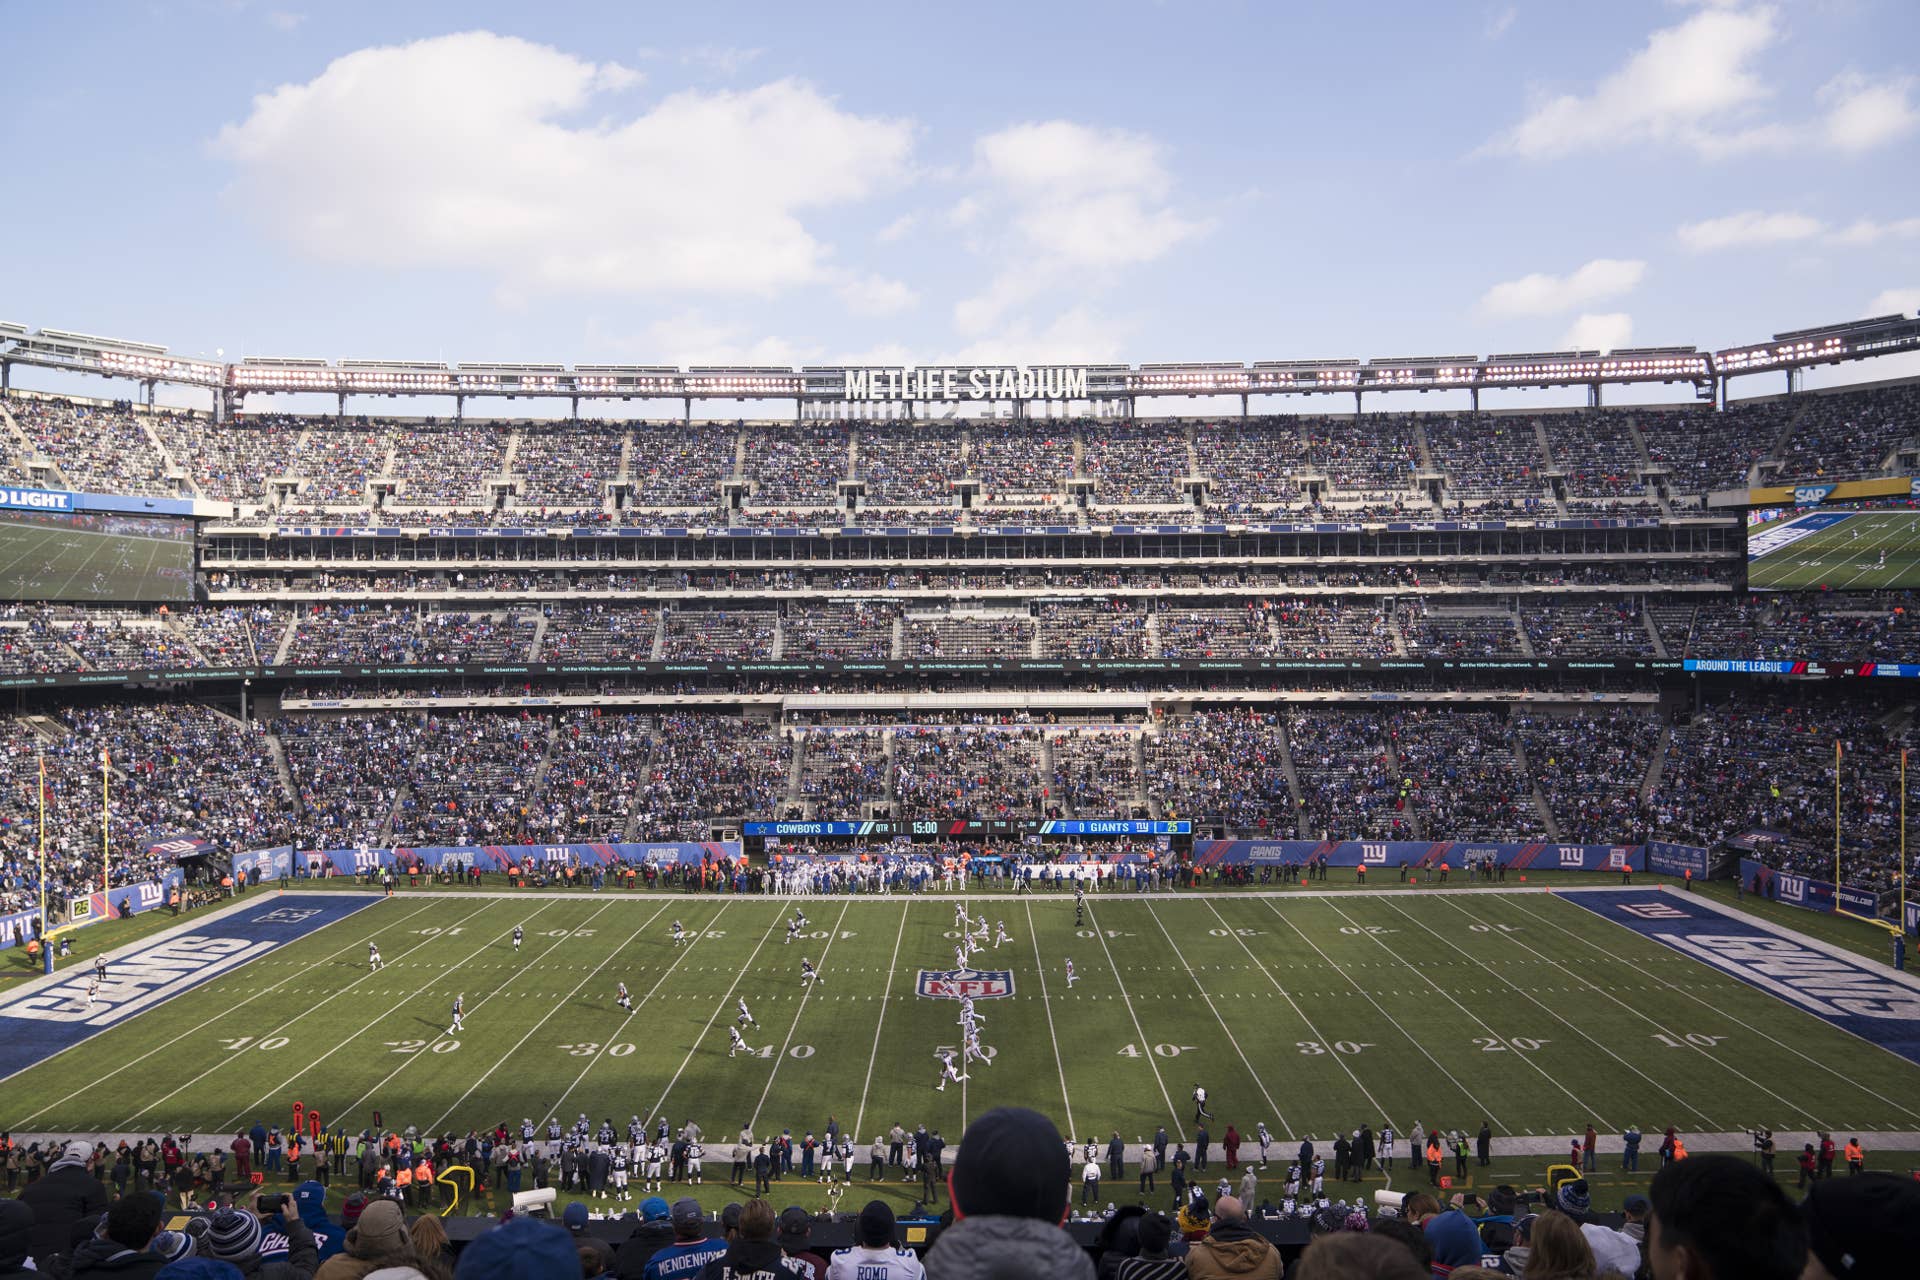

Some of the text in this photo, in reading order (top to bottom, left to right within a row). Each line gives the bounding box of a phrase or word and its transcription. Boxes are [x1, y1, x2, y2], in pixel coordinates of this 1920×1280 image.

[844, 368, 1087, 399] METLIFE STADIUM
[1795, 488, 1827, 502] SAP
[1696, 660, 1782, 672] AROUND THE LEAGUE
[777, 824, 833, 834] COWBOYS 0
[876, 824, 896, 833] QTR 1
[912, 822, 937, 833] 15:00
[1079, 822, 1084, 832] 0
[1090, 822, 1129, 832] GIANTS
[1167, 822, 1177, 832] 25
[442, 852, 474, 864] GIANTS
[647, 848, 679, 861] GIANTS
[1250, 846, 1282, 857] GIANTS
[1464, 849, 1497, 862] GIANTS
[75, 901, 89, 914] 25
[548, 929, 597, 937] 20
[810, 930, 856, 940] 40
[1208, 928, 1257, 937] 30
[1339, 926, 1388, 935] 20
[1469, 924, 1513, 933] 10
[0, 936, 254, 1022] GIANTS
[1685, 934, 1920, 1020] GIANTS
[928, 982, 1002, 995] NFL
[223, 1037, 290, 1050] 10
[391, 1039, 460, 1053] 20
[1472, 1037, 1541, 1051] 20
[1650, 1033, 1718, 1048] 10
[570, 1043, 636, 1056] 30
[756, 1045, 815, 1058] 40
[1117, 1043, 1182, 1058] 40
[1296, 1041, 1362, 1054] 30
[614, 1158, 626, 1167] 75
[259, 1232, 328, 1256] GIAS
[858, 1266, 888, 1280] ROMO
